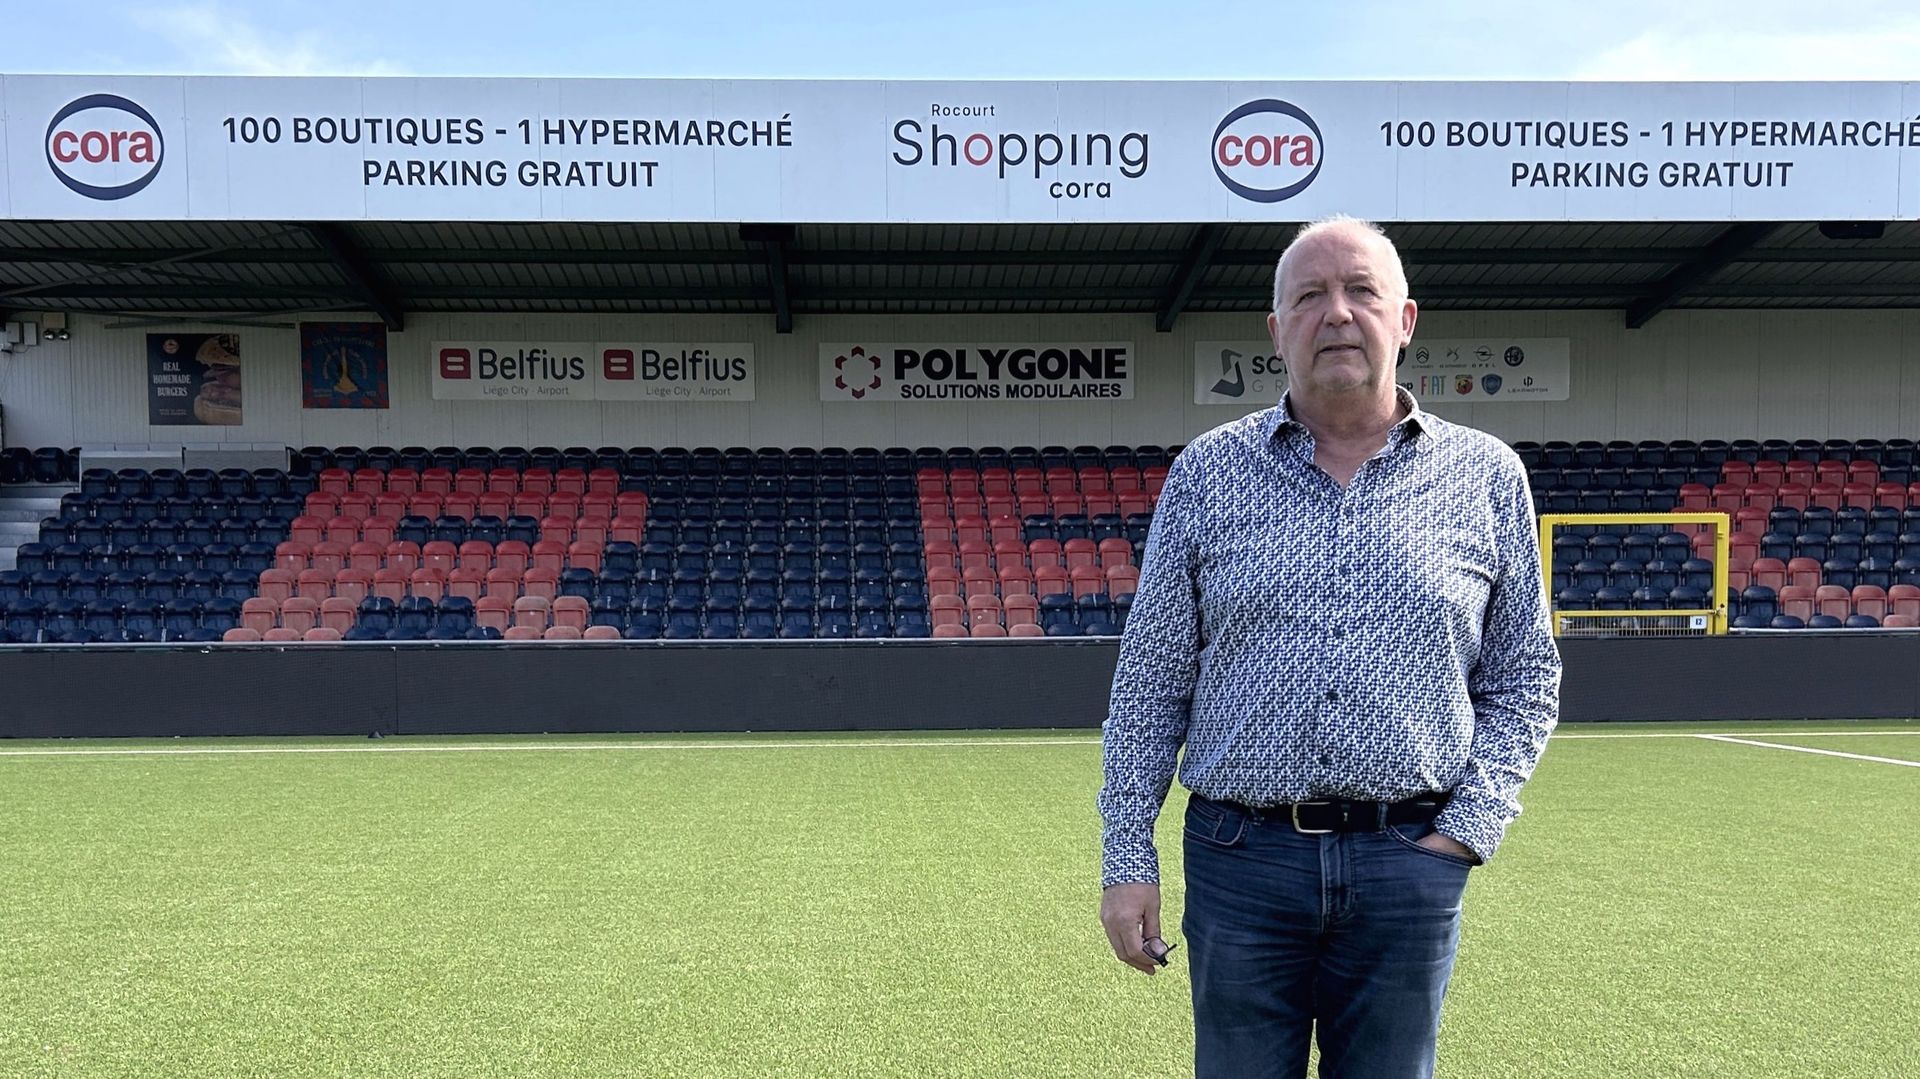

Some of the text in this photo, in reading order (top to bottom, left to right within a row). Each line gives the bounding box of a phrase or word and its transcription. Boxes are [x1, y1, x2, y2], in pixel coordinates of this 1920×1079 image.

[931, 103, 995, 117] Rocourt
[222, 117, 282, 145] 100
[293, 117, 484, 147] BOUTIQUES
[518, 119, 530, 145] 1
[543, 113, 793, 147] HYPERMARCHÉ
[1380, 120, 1436, 147] 100
[1446, 120, 1629, 149] BOUTIQUES
[1661, 121, 1673, 147] 1
[51, 131, 155, 163] cora
[892, 119, 1149, 179] Shopping
[1218, 134, 1315, 167] cora
[363, 159, 659, 188] PARKING GRATUIT
[1511, 161, 1794, 188] PARKING GRATUIT
[1049, 181, 1111, 199] cora
[162, 361, 181, 372] REAL
[478, 348, 585, 381] Belfius
[641, 349, 747, 382] Belfius
[894, 347, 1128, 381] POLYGONE
[152, 373, 192, 385] HOMEMADE
[157, 386, 188, 397] BURGERS
[511, 384, 529, 398] City
[537, 385, 569, 398] Airport
[673, 385, 692, 399] City
[700, 385, 731, 399] Airport
[900, 383, 1122, 399] SOLUTIONS MODULAIRES
[1420, 375, 1447, 396] FIAT
